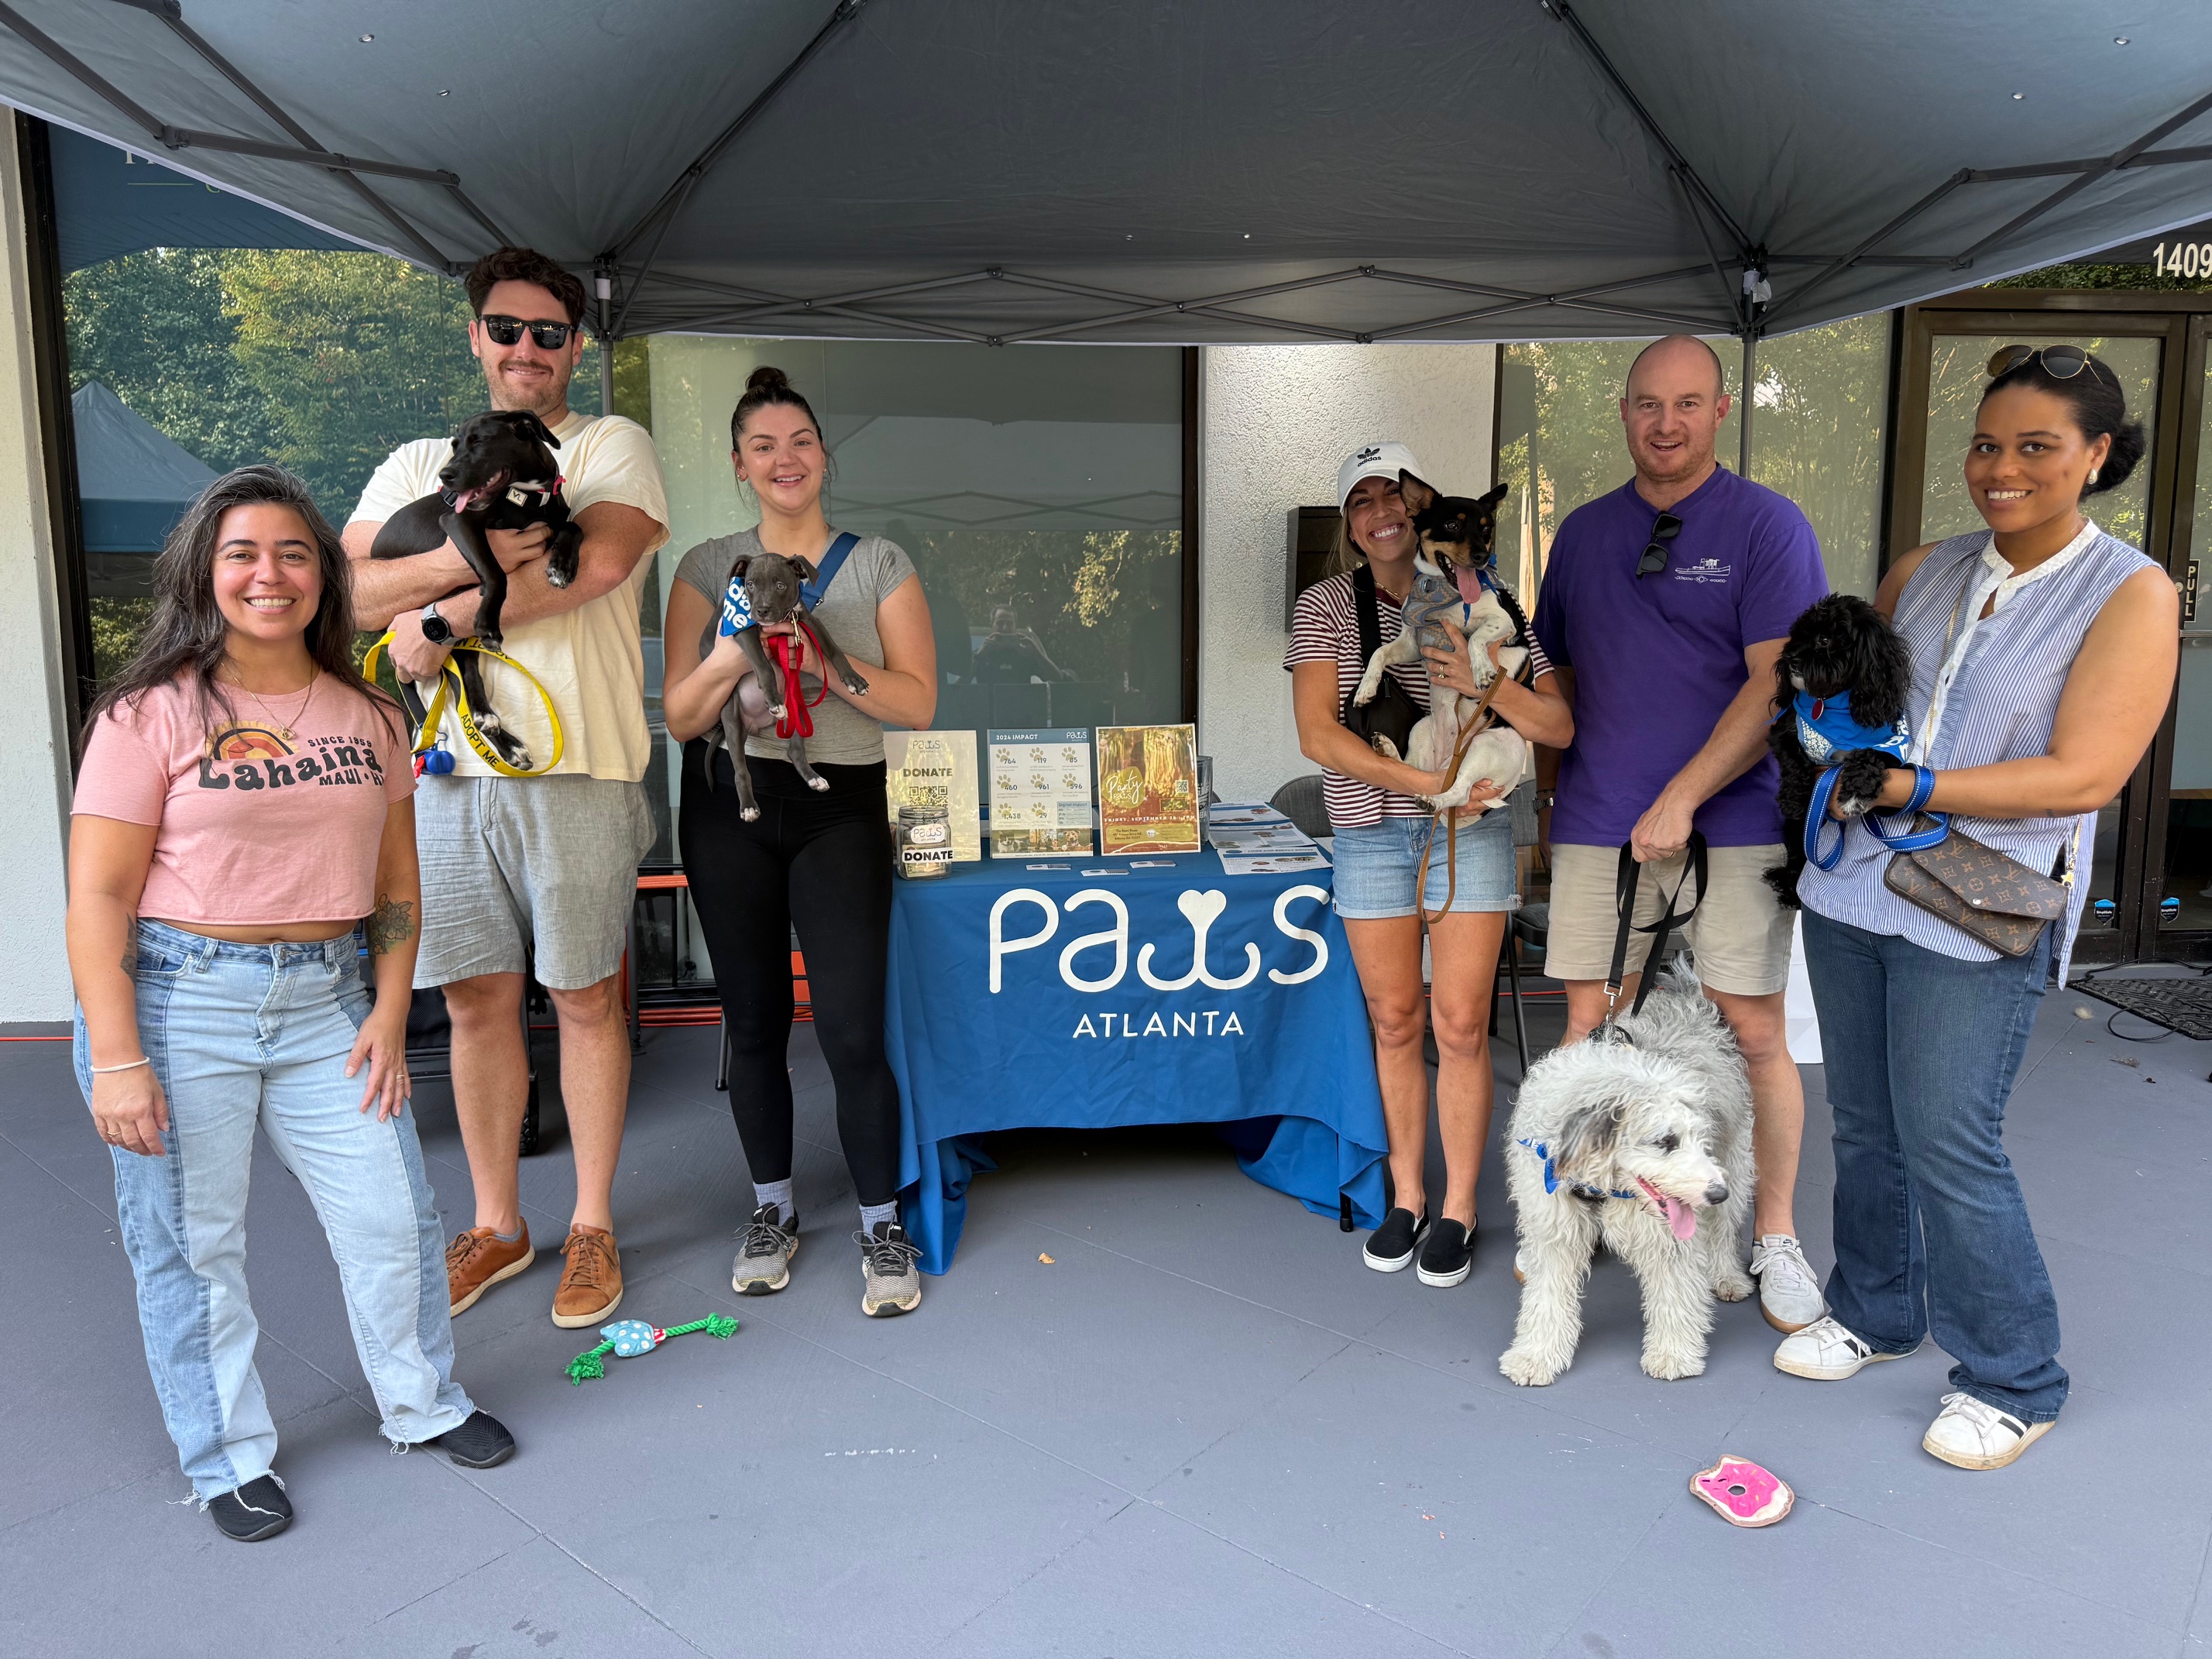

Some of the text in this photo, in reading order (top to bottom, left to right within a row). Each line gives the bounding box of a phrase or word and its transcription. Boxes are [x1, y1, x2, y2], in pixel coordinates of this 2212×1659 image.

[2153, 242, 2212, 278] 1409
[1358, 456, 1382, 467] adidas
[2185, 565, 2197, 617] PULL
[307, 736, 373, 748] SINCE 1959
[461, 713, 500, 768] ADOPT ME
[198, 745, 383, 790] Lahaina
[319, 768, 362, 786] MAUI
[903, 768, 953, 778] DONATE
[1106, 770, 1142, 804] Party
[904, 850, 953, 861] DONATE
[1072, 1011, 1245, 1039] ATLANTA
